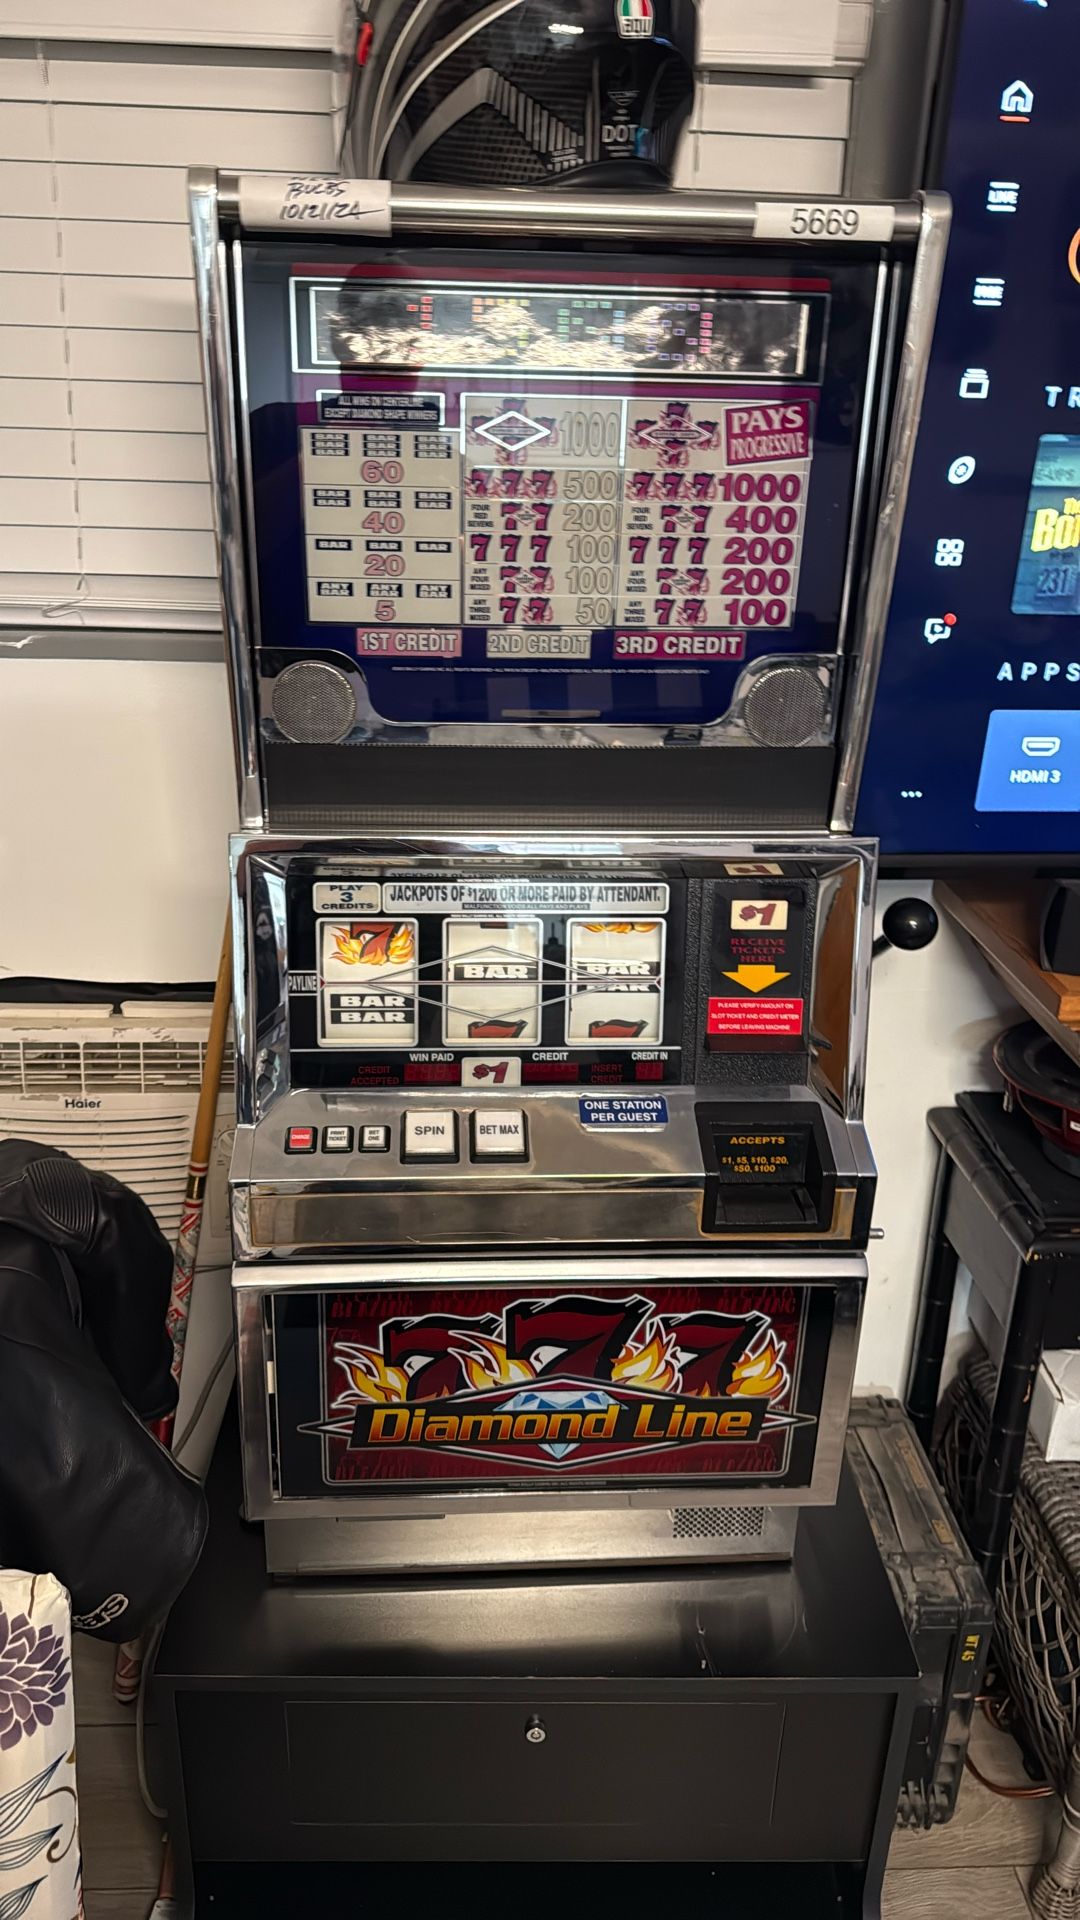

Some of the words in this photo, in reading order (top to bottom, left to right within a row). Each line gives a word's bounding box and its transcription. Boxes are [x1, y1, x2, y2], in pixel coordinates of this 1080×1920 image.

[601, 124, 639, 143] DOT
[790, 208, 860, 235] 5669
[730, 406, 804, 434] PAYS
[559, 411, 620, 457] 1000
[730, 432, 806, 461] PROGRESSIVE
[361, 460, 404, 484] 60
[563, 470, 618, 500] 500
[718, 473, 801, 502] 1000
[361, 511, 405, 534] 40
[563, 503, 617, 532] 200
[725, 505, 797, 534] 400
[319, 541, 348, 549] BAR
[368, 542, 398, 550] BAR
[419, 543, 448, 551] BAR
[567, 535, 614, 563] 100
[723, 537, 795, 565] 200
[363, 554, 406, 576] 20
[565, 566, 613, 595] 100
[720, 568, 791, 596] 200
[375, 599, 396, 621] 5
[576, 597, 612, 625] 50
[724, 599, 787, 626] 100
[360, 633, 389, 651] 1ST
[395, 633, 458, 651] CREDIT
[487, 634, 522, 652] 2ND
[527, 634, 589, 653] CREDIT
[616, 636, 659, 654] 3RD
[663, 636, 742, 656] CREDIT
[997, 662, 1080, 682] APPS
[1009, 769, 1049, 783] HDMI
[1049, 769, 1061, 783] 3
[340, 892, 353, 902] 3
[390, 885, 448, 902] JACKPOTS
[451, 885, 466, 901] OF
[468, 886, 497, 901] $1200
[500, 886, 516, 901] OR
[518, 886, 549, 901] MORE
[551, 886, 577, 901] PAID
[579, 886, 594, 902] BY
[598, 886, 661, 902] ATTENDANT.
[463, 965, 528, 979] BAR
[587, 964, 651, 975] BAR
[288, 976, 317, 991] PAYLINE
[340, 996, 406, 1007] BAR
[340, 1012, 406, 1022] BAR
[409, 1053, 430, 1061] WIN
[431, 1053, 454, 1061] PAID
[532, 1052, 569, 1061] CREDIT
[631, 1052, 659, 1060] CREDIT
[660, 1052, 669, 1060] IN
[358, 1066, 391, 1074] CREDIT
[472, 1062, 509, 1084] $1
[591, 1064, 623, 1072] INSERT
[351, 1077, 400, 1085] ACCEPTED
[591, 1075, 623, 1083] CREDIT
[65, 1098, 101, 1109] Haier
[584, 1101, 610, 1110] ONE
[612, 1101, 662, 1110] STATION
[591, 1113, 616, 1121] PER
[618, 1113, 658, 1121] GUEST
[414, 1126, 445, 1136] SPIN
[479, 1125, 498, 1135] BET
[499, 1125, 519, 1135] MAX
[722, 1156, 735, 1165] $1,
[751, 1156, 769, 1165] $10,
[770, 1156, 789, 1165] $20,
[734, 1165, 753, 1173] $50,
[367, 1405, 621, 1443] Diamond
[633, 1406, 754, 1439] Line
